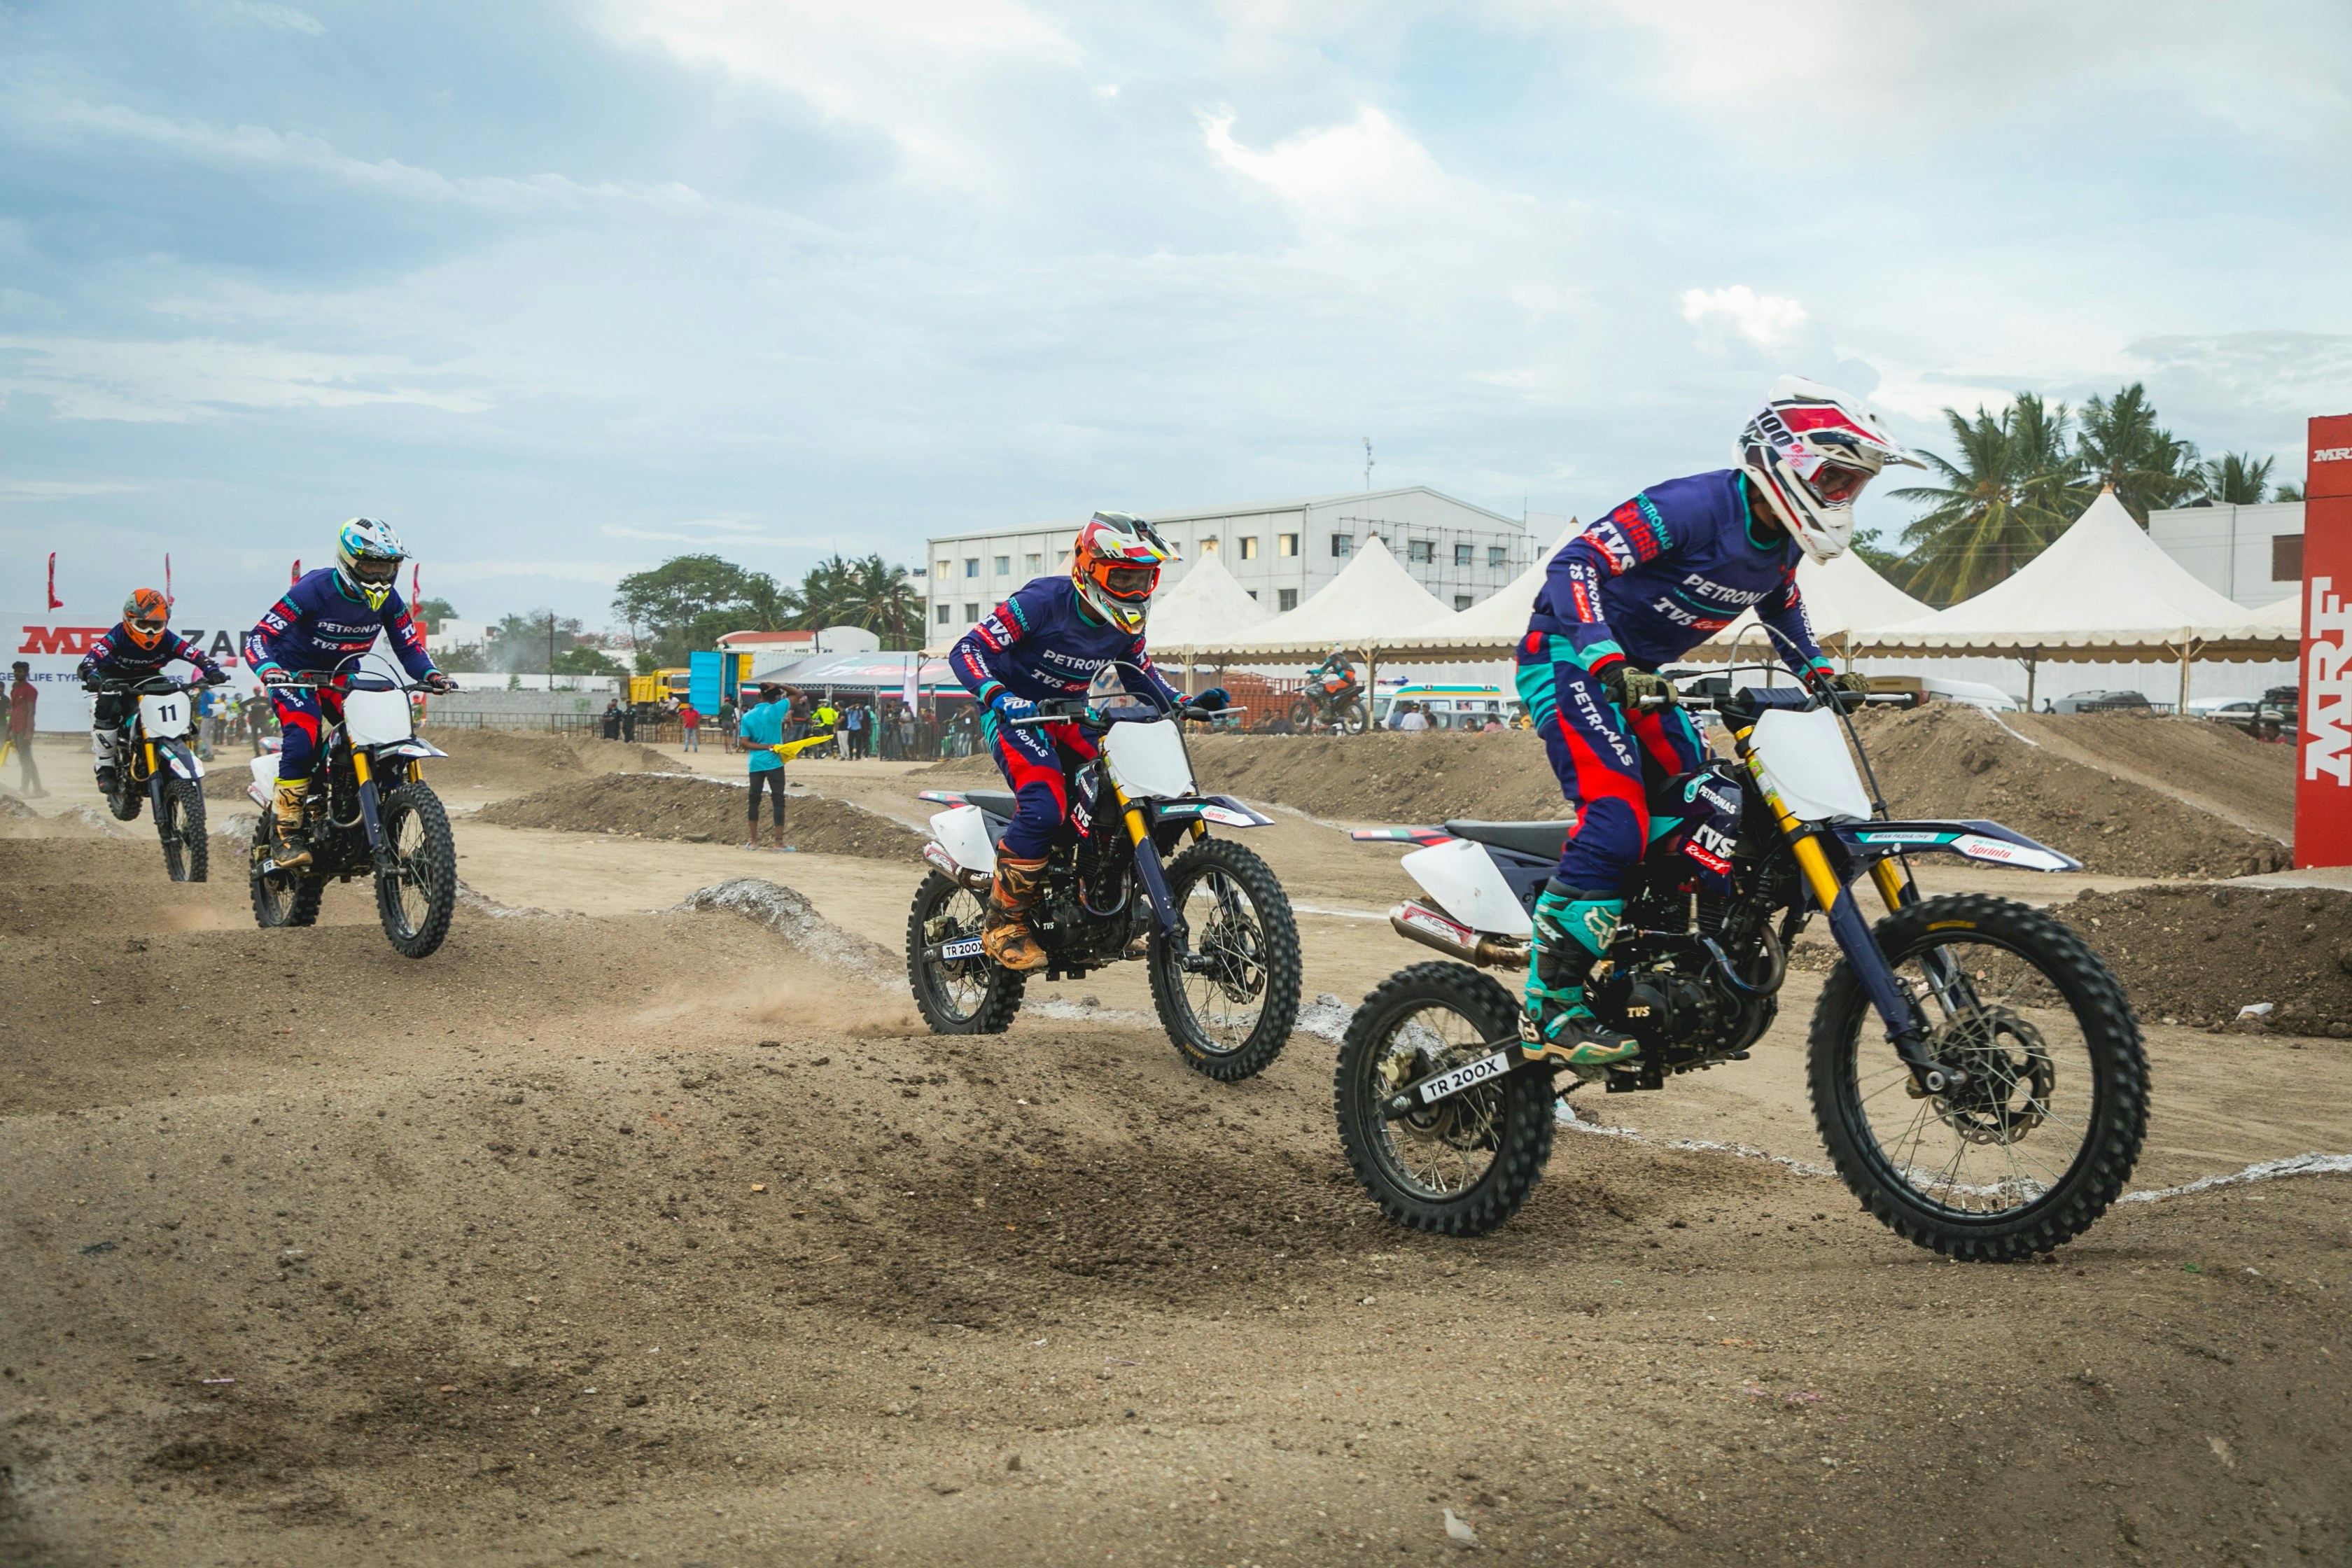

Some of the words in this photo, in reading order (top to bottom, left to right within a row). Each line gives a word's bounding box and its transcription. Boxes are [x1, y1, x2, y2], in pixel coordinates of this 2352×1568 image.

[1756, 407, 1793, 447] 100
[2313, 447, 2352, 462] MR
[1635, 493, 1674, 550] PETRONAS
[1590, 521, 1635, 571] TVS
[1683, 573, 1774, 605] PETRONA
[266, 611, 288, 630] VS
[1653, 597, 1698, 626] TVS
[312, 636, 340, 650] TVS
[981, 613, 1014, 647] TVS
[1043, 650, 1116, 671] PETRONA
[30, 673, 52, 682] LIFE
[1031, 669, 1065, 689] TVS
[2305, 577, 2352, 786] MRF
[158, 704, 176, 722] 11
[1016, 729, 1049, 757] RONAS
[1698, 785, 1736, 814] PETRONAS
[1074, 802, 1092, 827] TVS
[1692, 824, 1737, 859] TVS
[1968, 844, 2011, 858] Sprinta
[1686, 844, 1730, 870] Racing
[946, 946, 957, 956] TR
[1627, 1006, 1650, 1018] TVS
[1427, 1079, 1449, 1097] TR
[1452, 1059, 1499, 1087] 200X
